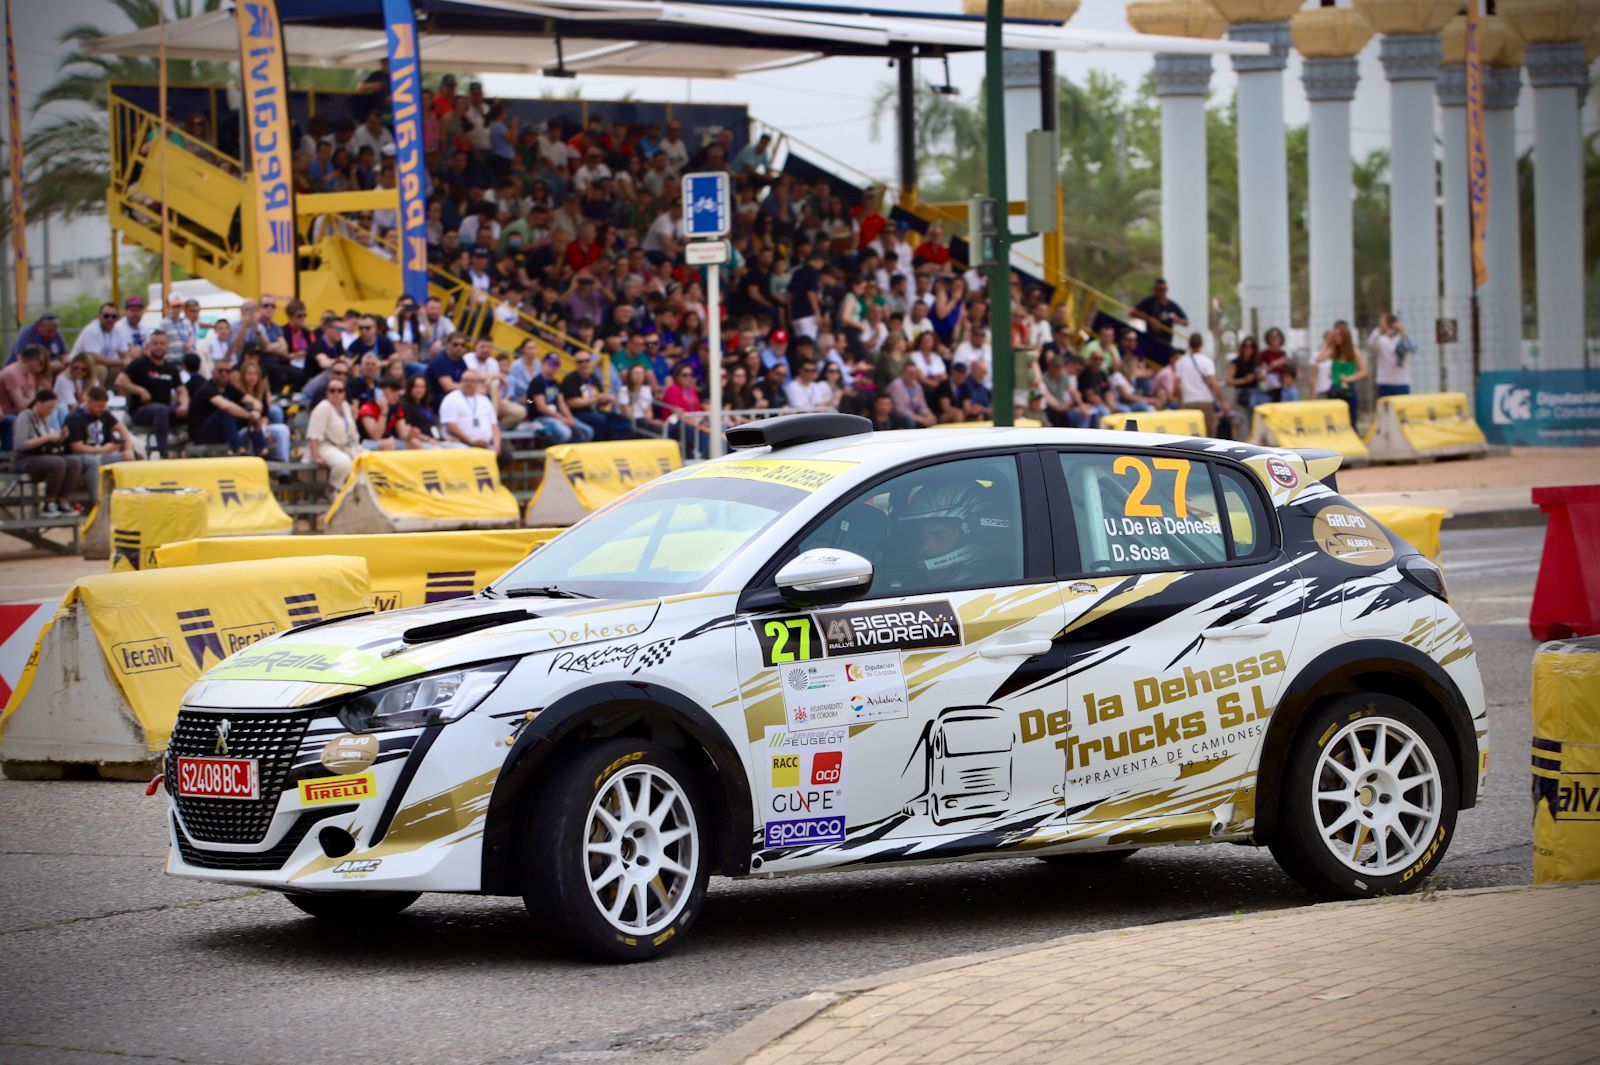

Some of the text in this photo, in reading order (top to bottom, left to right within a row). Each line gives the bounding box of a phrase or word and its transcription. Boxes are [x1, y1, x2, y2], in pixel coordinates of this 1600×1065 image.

[1113, 456, 1191, 518] 27
[1147, 518, 1162, 535] la
[1164, 517, 1222, 535] Dehesa
[1326, 513, 1367, 529] GRUPO
[850, 610, 934, 632] SIERRA
[549, 623, 639, 645] Dehesa
[764, 618, 811, 664] 27
[829, 640, 855, 650] RALLYE
[856, 623, 957, 647] MORENA
[547, 643, 640, 676] Racing
[1019, 649, 1287, 744] De la Dehesa
[783, 736, 845, 747] PEUGEOT
[1055, 710, 1207, 772] Trucks
[1167, 749, 1183, 762] DE
[1192, 724, 1263, 755] CAMIONES
[773, 756, 798, 769] RACC
[816, 769, 840, 782] acp
[305, 777, 369, 800] PIRELLI
[769, 819, 841, 845] sparco
